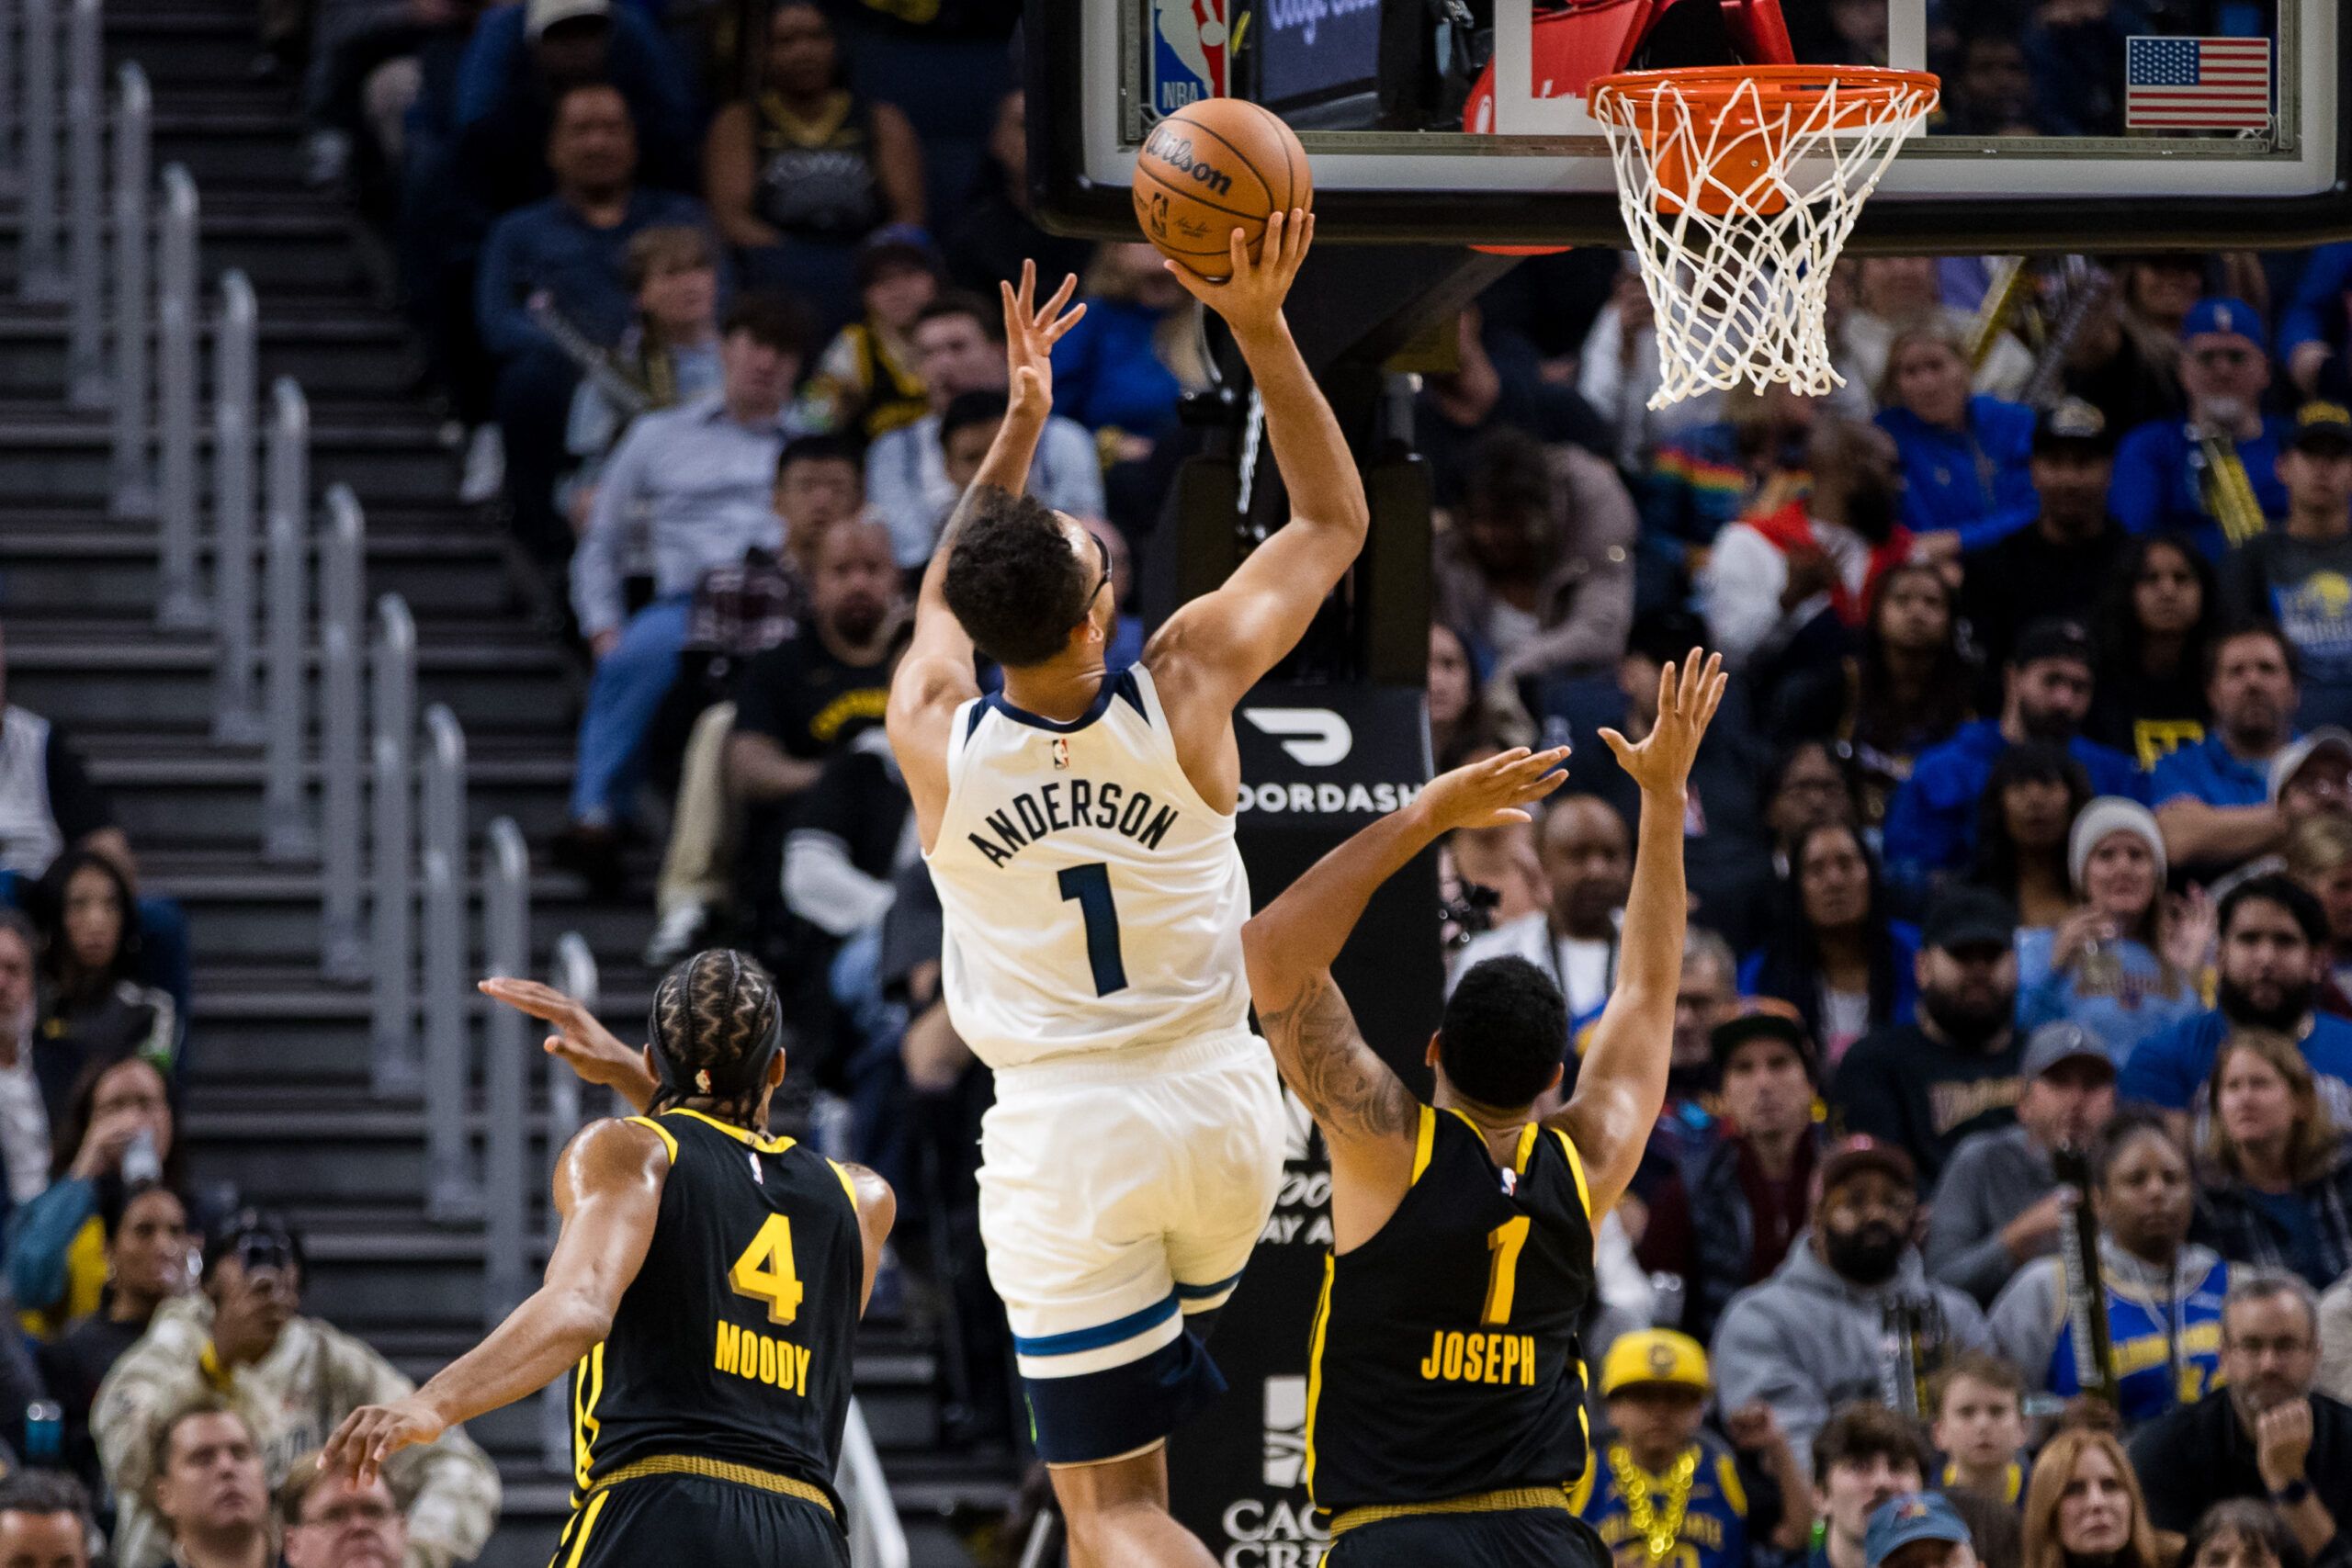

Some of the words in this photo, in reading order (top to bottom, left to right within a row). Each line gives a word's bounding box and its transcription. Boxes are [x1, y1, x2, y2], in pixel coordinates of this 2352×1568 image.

[1162, 81, 1198, 108] NBA
[1147, 126, 1233, 197] Wilson
[967, 779, 1179, 869] ANDERSON
[1237, 783, 1424, 813] OORDASH
[1057, 862, 1129, 998] 1
[728, 1212, 803, 1326] 4
[1479, 1215, 1531, 1328] 1
[714, 1319, 811, 1397] MOODY
[1421, 1331, 1534, 1386] JOSEPH
